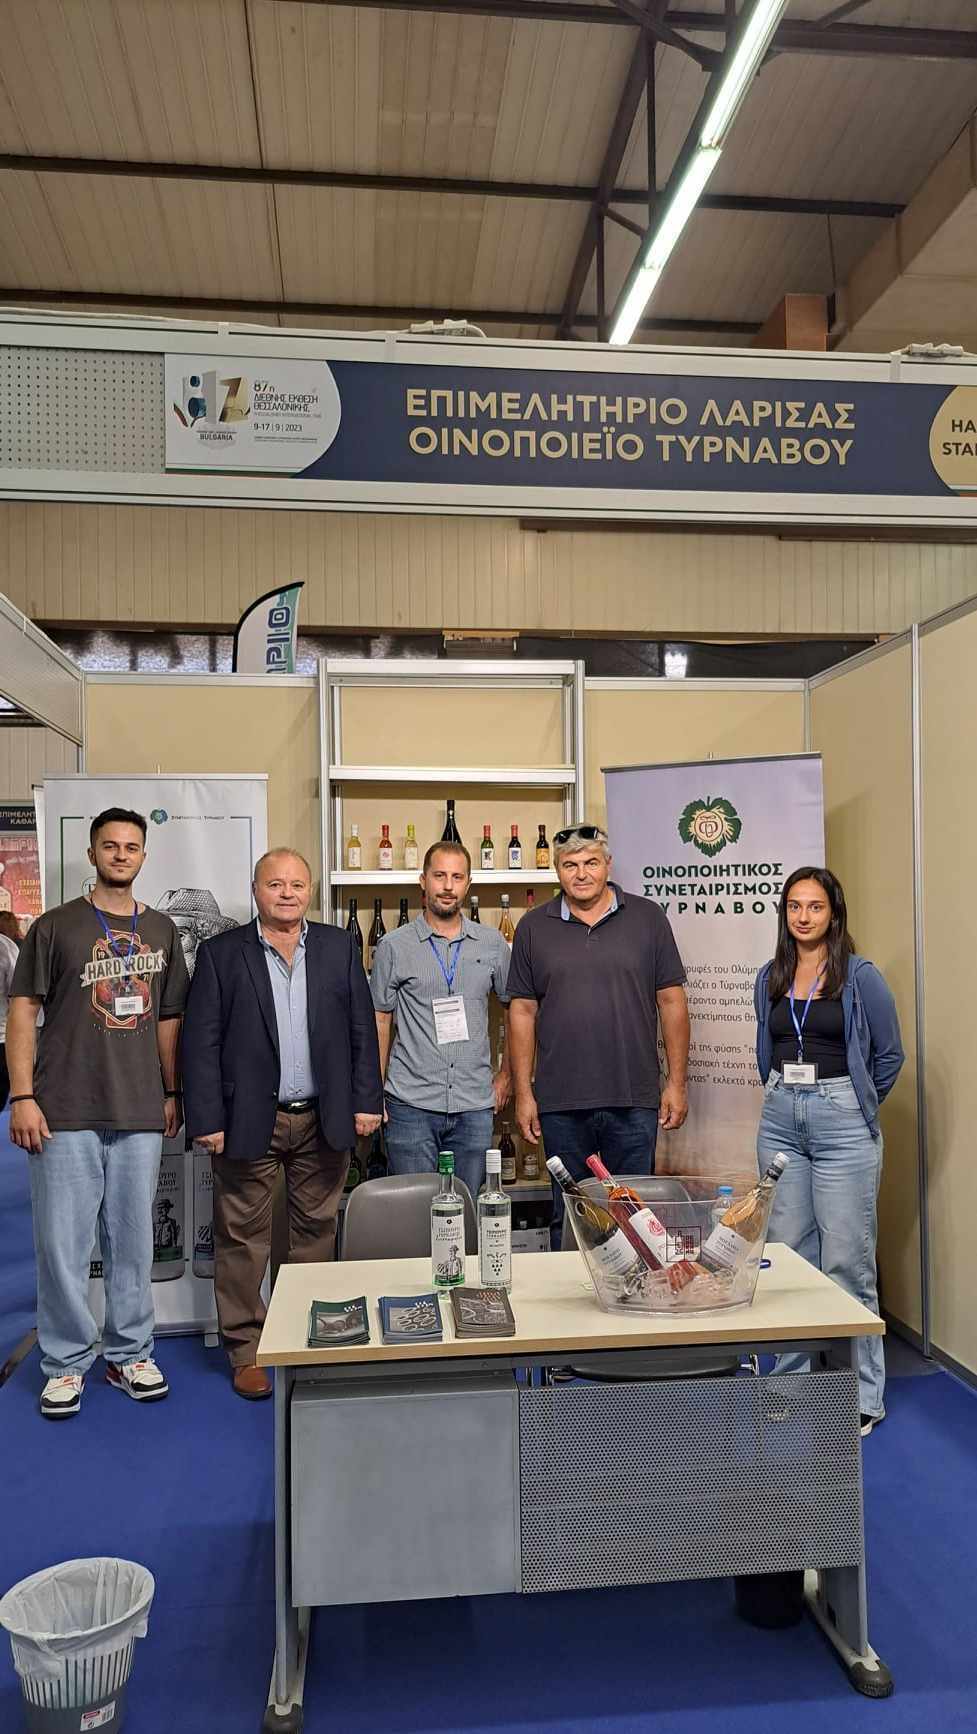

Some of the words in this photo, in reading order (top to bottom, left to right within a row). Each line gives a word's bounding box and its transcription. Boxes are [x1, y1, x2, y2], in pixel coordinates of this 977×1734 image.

[406, 388, 688, 425] ΕΠΙΜΕΛΗΤΗΡΙΟ
[699, 399, 856, 430] ΛΑΡΙΣΑΣ
[409, 425, 645, 461] ΟΙΝΟΠΟΙΕΪΟ
[655, 434, 854, 465] ΤΥΡΝΑΒΟΥ
[642, 863, 783, 878] ΟΙΝΟΠΟΙΗΤΙΚΟΣ
[642, 882, 783, 897] ΣΥΝΕΤΑΙΡΙΣΜΟΣ
[660, 901, 779, 914] ΥΡΝΑΒΟΥ
[87, 959, 121, 980] HARD
[128, 953, 161, 972] ROCK
[719, 979, 755, 992] Τύρναβο
